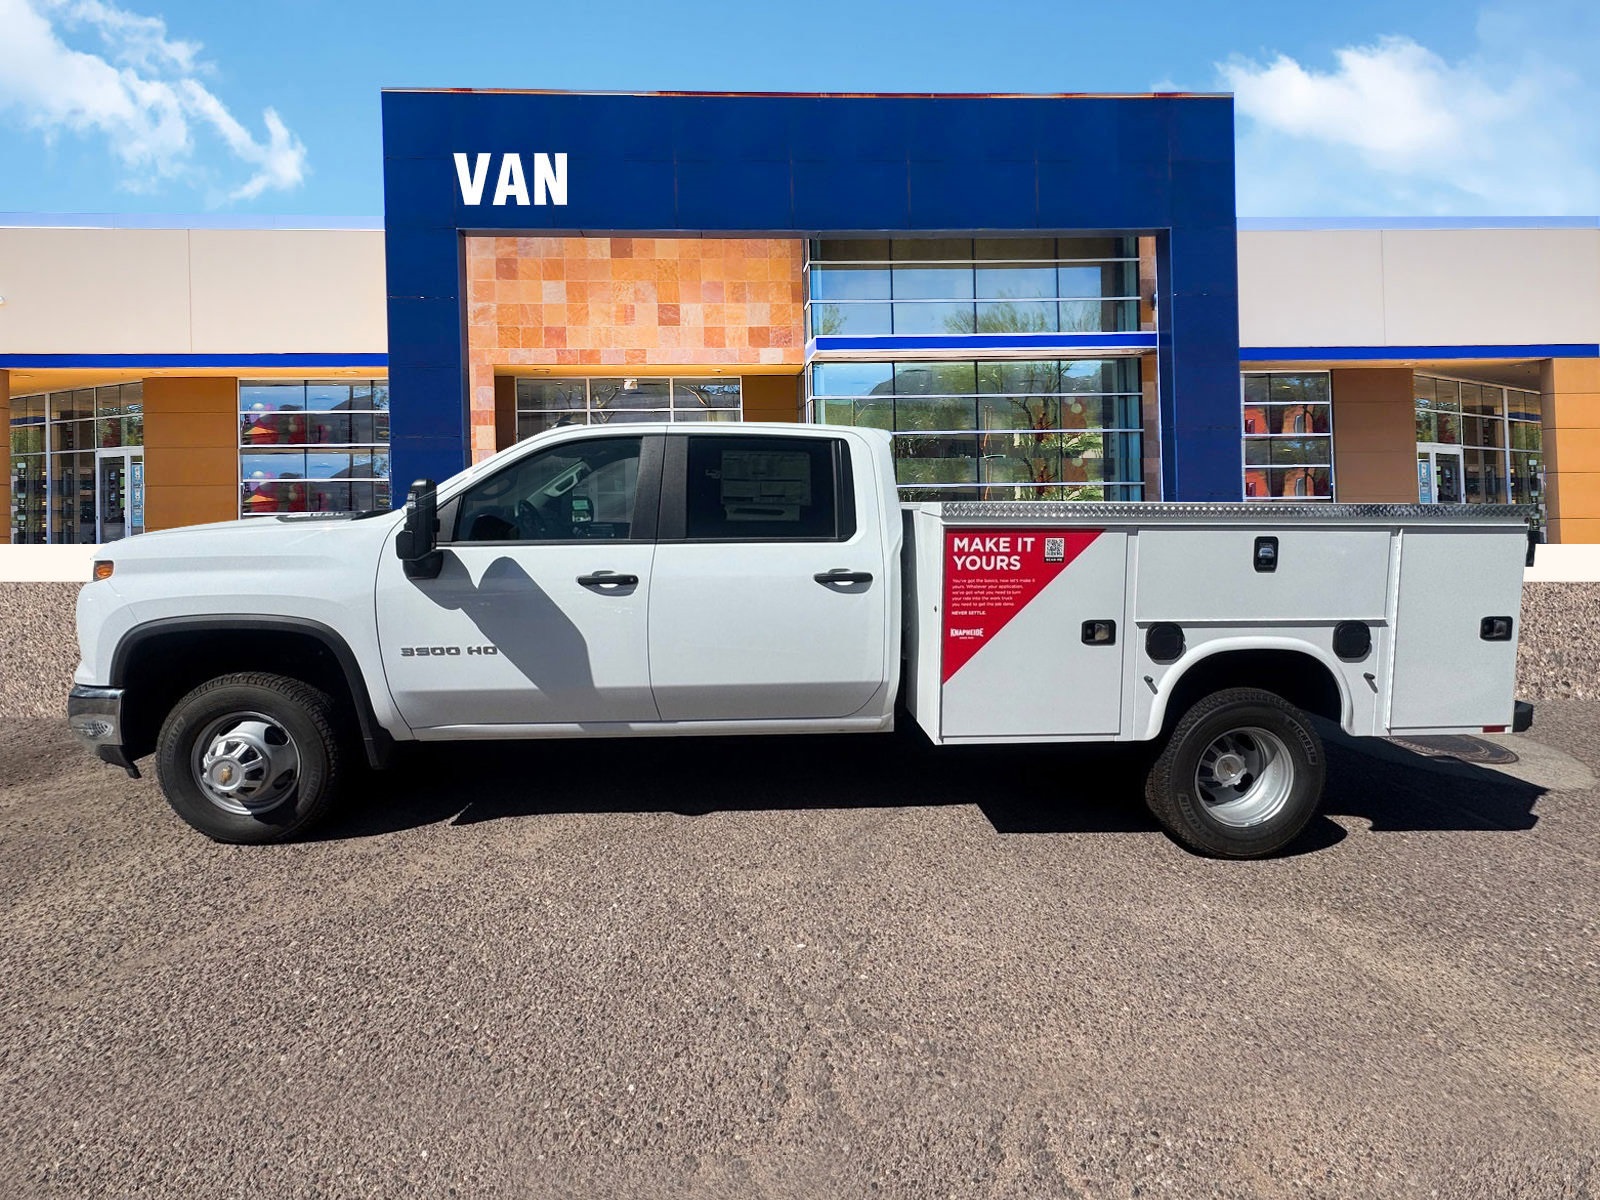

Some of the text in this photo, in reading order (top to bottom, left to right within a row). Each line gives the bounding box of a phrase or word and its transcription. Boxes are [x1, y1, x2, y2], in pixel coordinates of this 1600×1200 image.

[453, 153, 567, 205] VAN
[953, 537, 1035, 552] MAKE IT
[953, 555, 1021, 570] YOURS
[950, 628, 984, 637] KNAPHEIDE
[401, 646, 498, 656] 3500 HD
